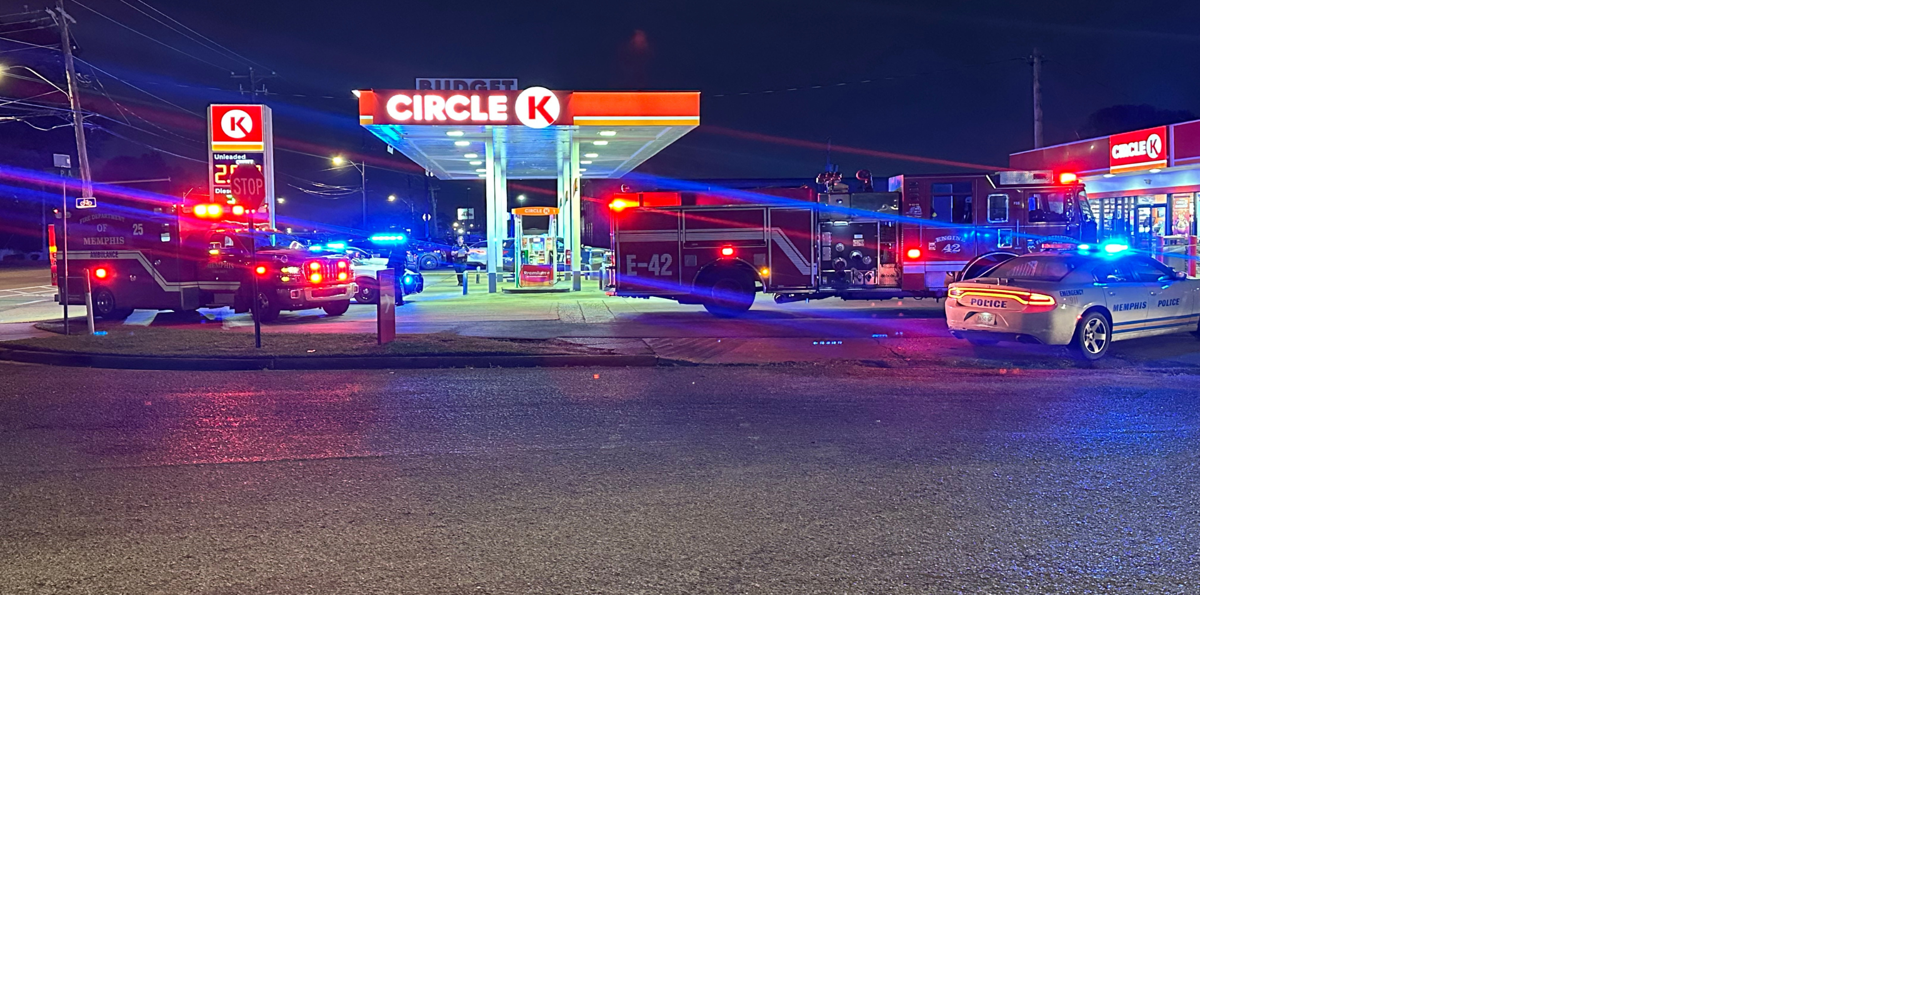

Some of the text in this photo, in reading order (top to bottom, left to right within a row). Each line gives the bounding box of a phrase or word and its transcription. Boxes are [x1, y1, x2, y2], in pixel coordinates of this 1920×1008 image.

[386, 94, 554, 124] CIRCLE K
[230, 116, 250, 136] K
[1112, 140, 1147, 159] CIRCLE
[233, 178, 263, 196] STOP
[80, 213, 126, 224] FIRE DEPARTMENT
[97, 224, 108, 232] OF
[132, 224, 143, 235] 25
[83, 237, 125, 245] MEMPHIS
[942, 244, 961, 254] 42
[626, 254, 673, 277] E-42
[970, 298, 1007, 309] POLICE
[1112, 301, 1148, 312] MEMPHIS
[1157, 298, 1180, 307] POLICE
